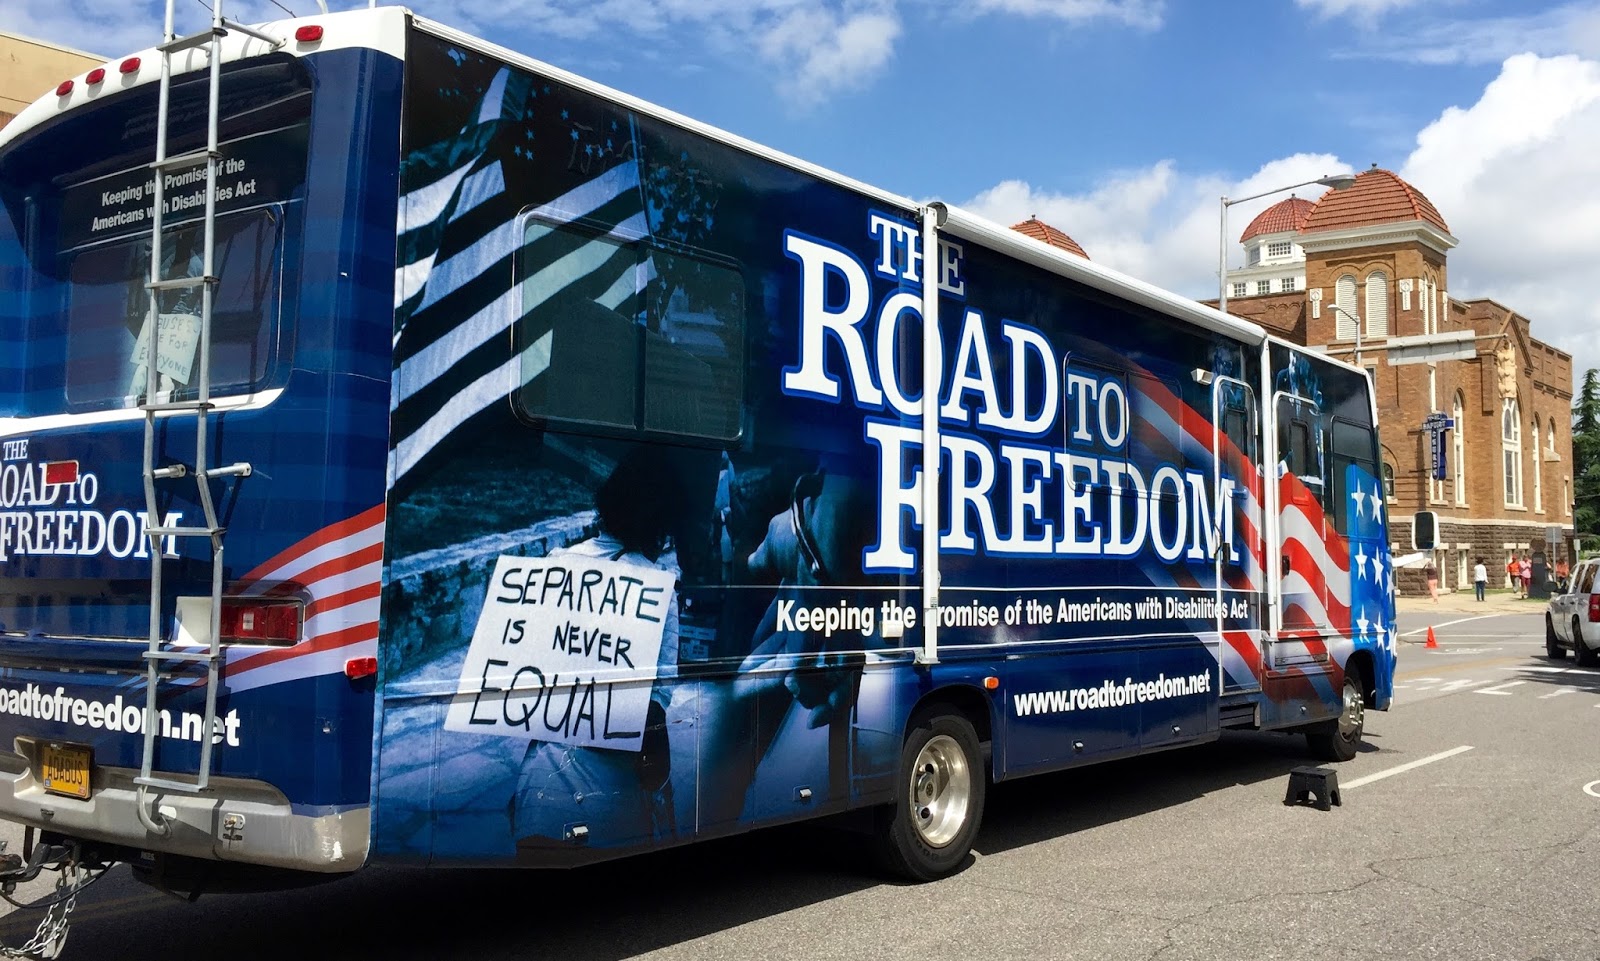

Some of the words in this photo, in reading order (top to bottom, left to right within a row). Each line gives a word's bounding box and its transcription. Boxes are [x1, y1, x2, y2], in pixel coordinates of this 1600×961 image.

[91, 209, 145, 232] Americans
[146, 201, 170, 218] wh
[172, 187, 233, 212] Disabiies
[235, 179, 256, 197] Act
[102, 185, 143, 207] Keeping
[145, 179, 156, 196] th
[164, 167, 208, 191] Promise
[226, 158, 245, 174] the
[871, 214, 964, 296] THE
[785, 233, 1058, 434] ROAD
[1068, 374, 1129, 448] TO
[3, 439, 29, 461] THE
[0, 462, 61, 508] OAD
[865, 421, 1239, 570] FREEDOM
[0, 510, 183, 562] FREEDOM
[497, 567, 664, 623] SEPARATE
[776, 599, 875, 638] Keeping
[881, 599, 916, 629] the
[923, 600, 999, 627] romise
[1004, 599, 1021, 626] of
[1026, 598, 1053, 625] the
[1056, 597, 1132, 623] Americans
[1136, 597, 1163, 620] with
[1230, 599, 1249, 619] Act
[502, 618, 526, 645] IS
[552, 620, 635, 670] NEVER
[469, 658, 641, 740] EQUAL
[1014, 668, 1211, 717] www.roadtofreedom.net
[48, 756, 82, 785] ADABUS
